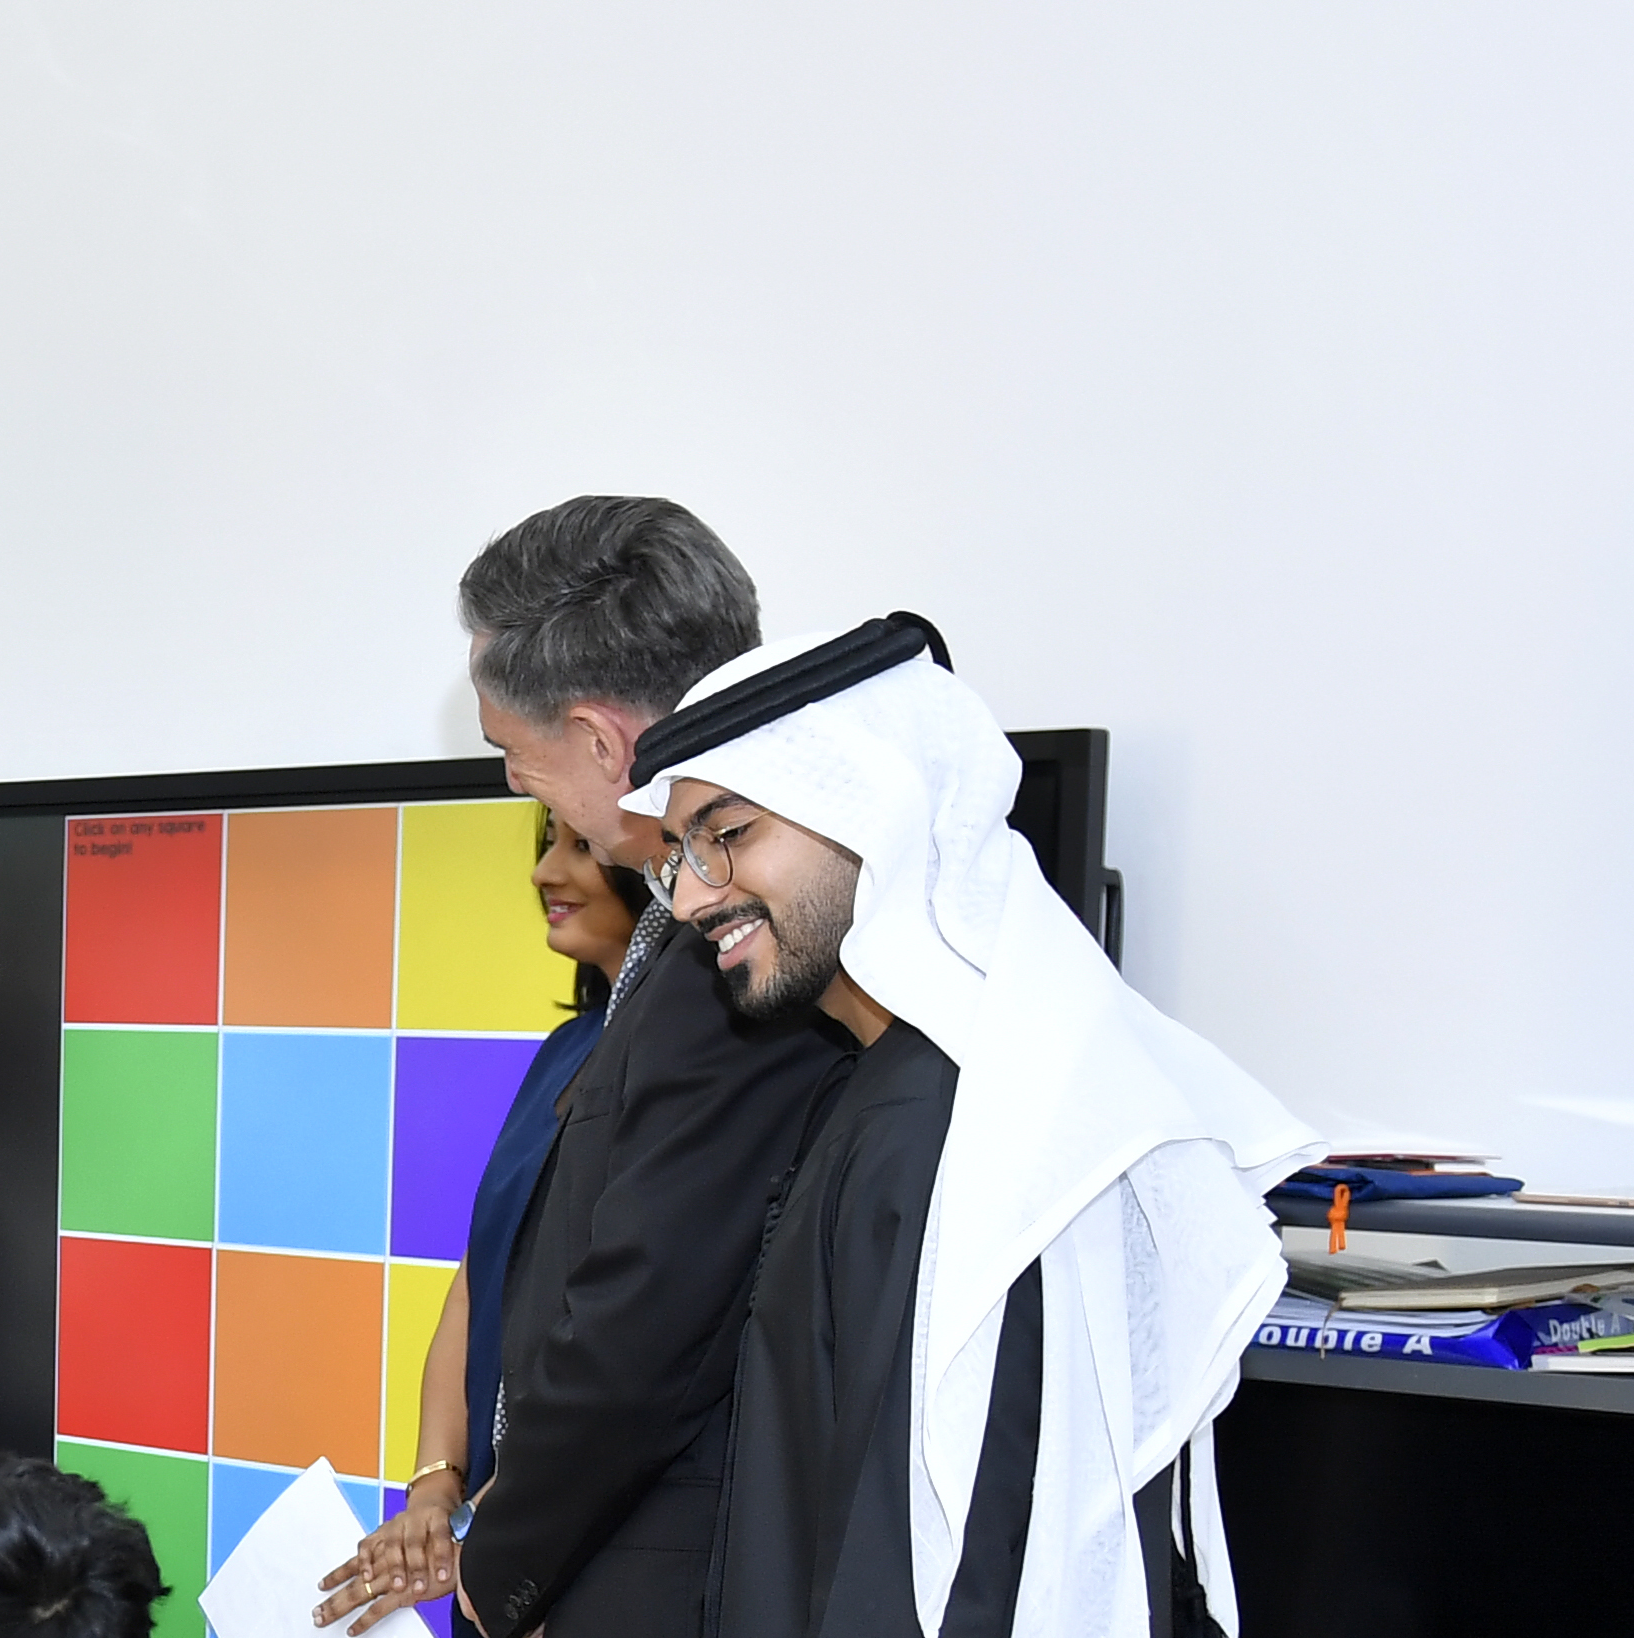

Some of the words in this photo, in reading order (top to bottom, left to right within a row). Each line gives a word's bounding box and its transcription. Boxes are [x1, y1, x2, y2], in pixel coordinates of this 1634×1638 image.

[74, 822, 105, 837] Click
[110, 824, 126, 835] on
[131, 823, 153, 837] any
[158, 821, 205, 837] square
[74, 843, 87, 856] to
[1258, 1325, 1383, 1354] ouble
[1402, 1333, 1434, 1356] A
[1548, 1314, 1606, 1344] Double
